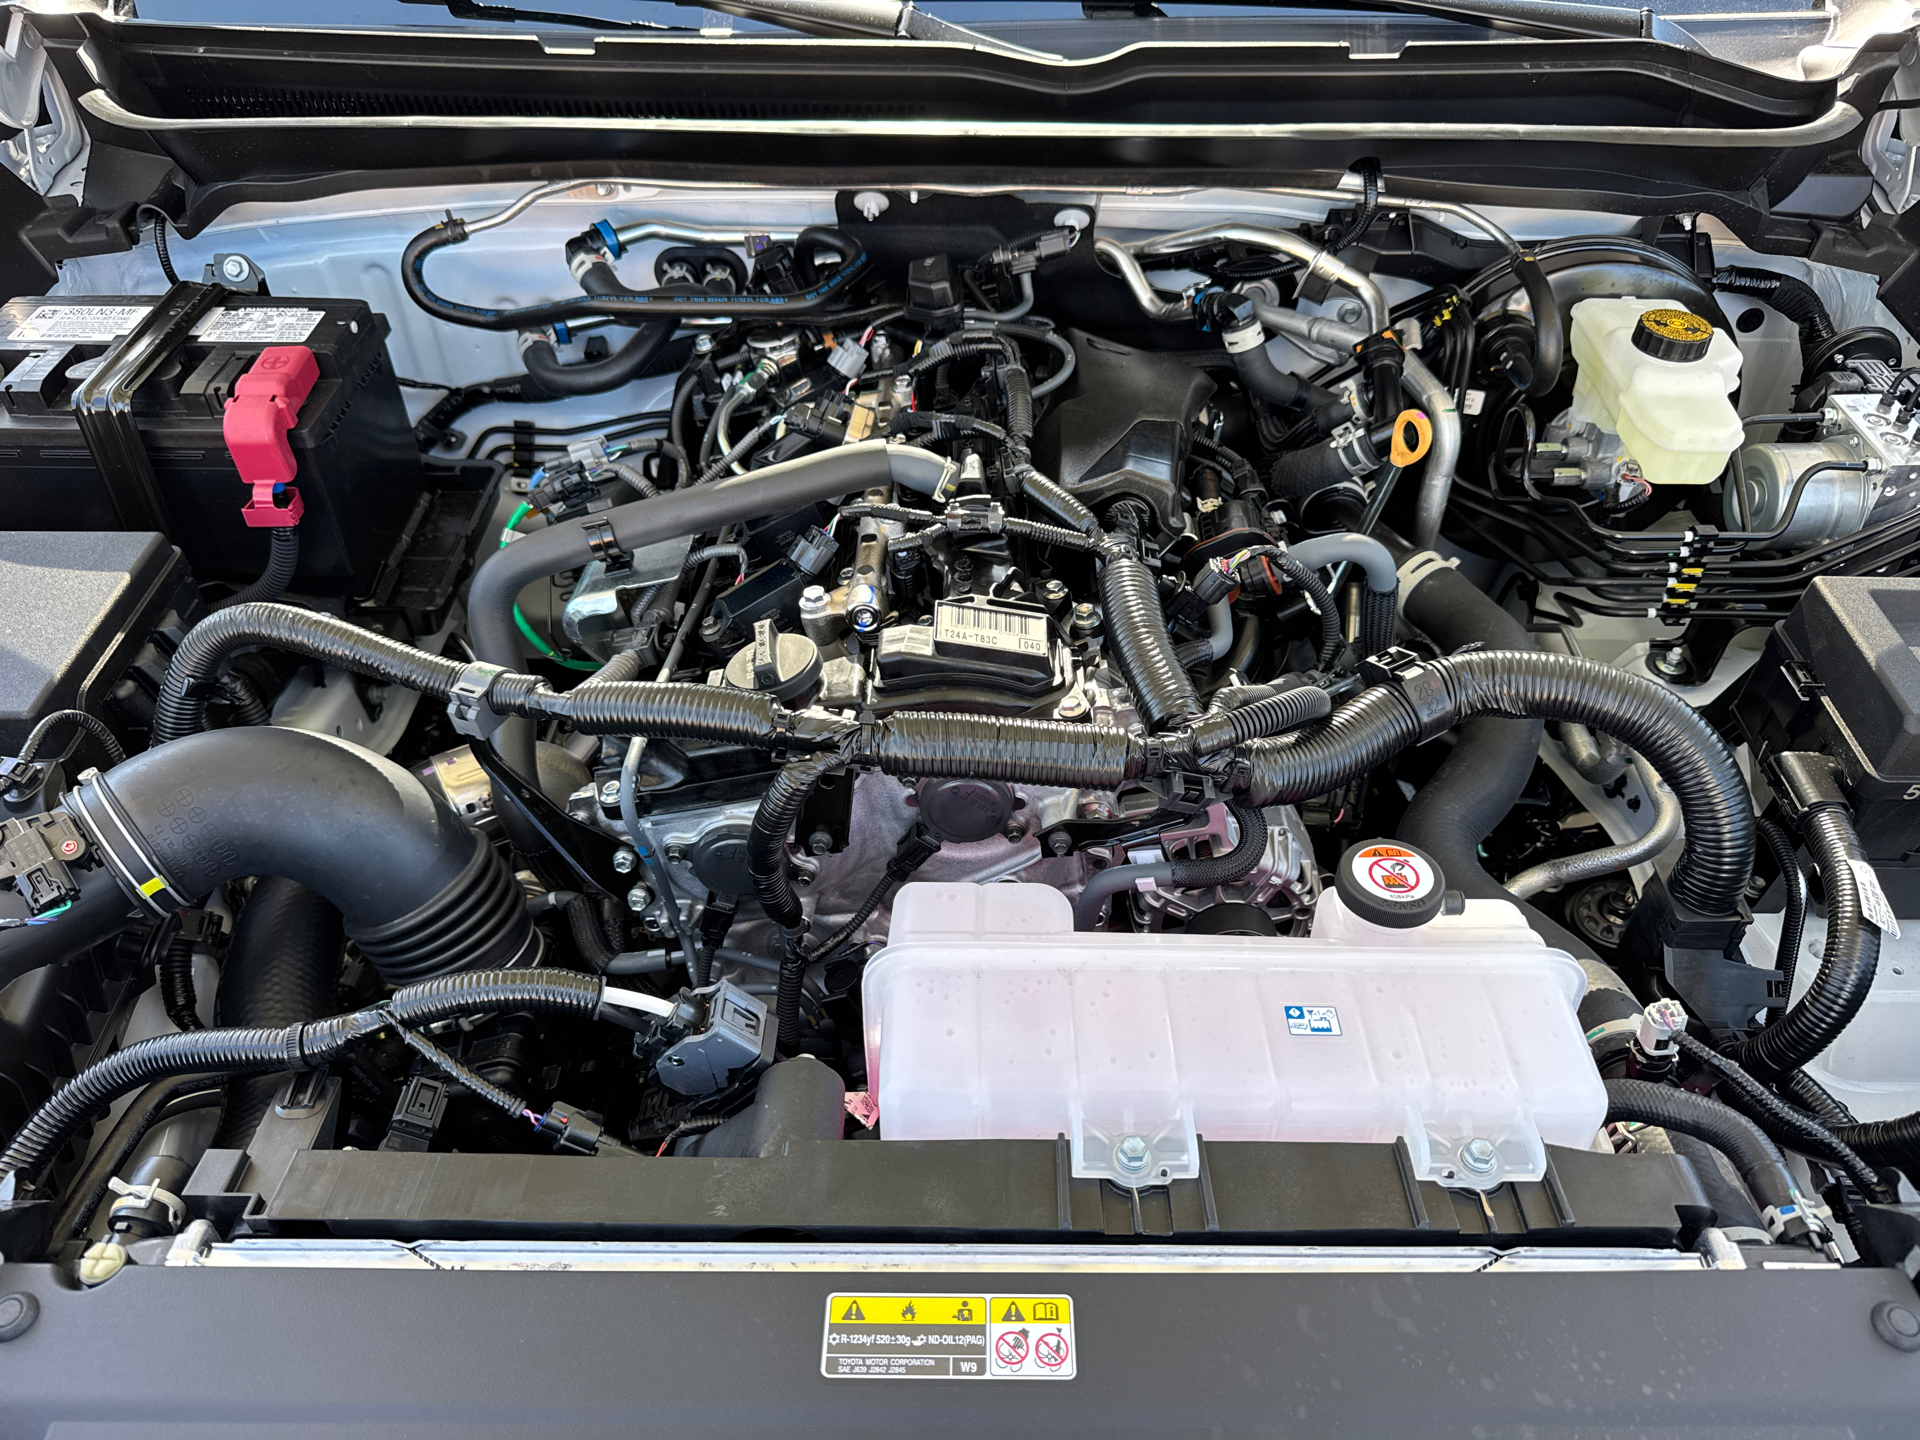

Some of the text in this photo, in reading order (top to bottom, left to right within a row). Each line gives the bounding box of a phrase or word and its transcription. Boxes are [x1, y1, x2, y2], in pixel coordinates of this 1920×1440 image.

[64, 307, 140, 316] 380LN3-MF
[944, 629, 997, 645] T24A-T83C
[1024, 641, 1041, 651] 040
[841, 1334, 985, 1347] R-1234yf 520±30g ND-OIL12(PAG)
[890, 1358, 935, 1366] CORPORATION
[960, 1361, 978, 1373] W9
